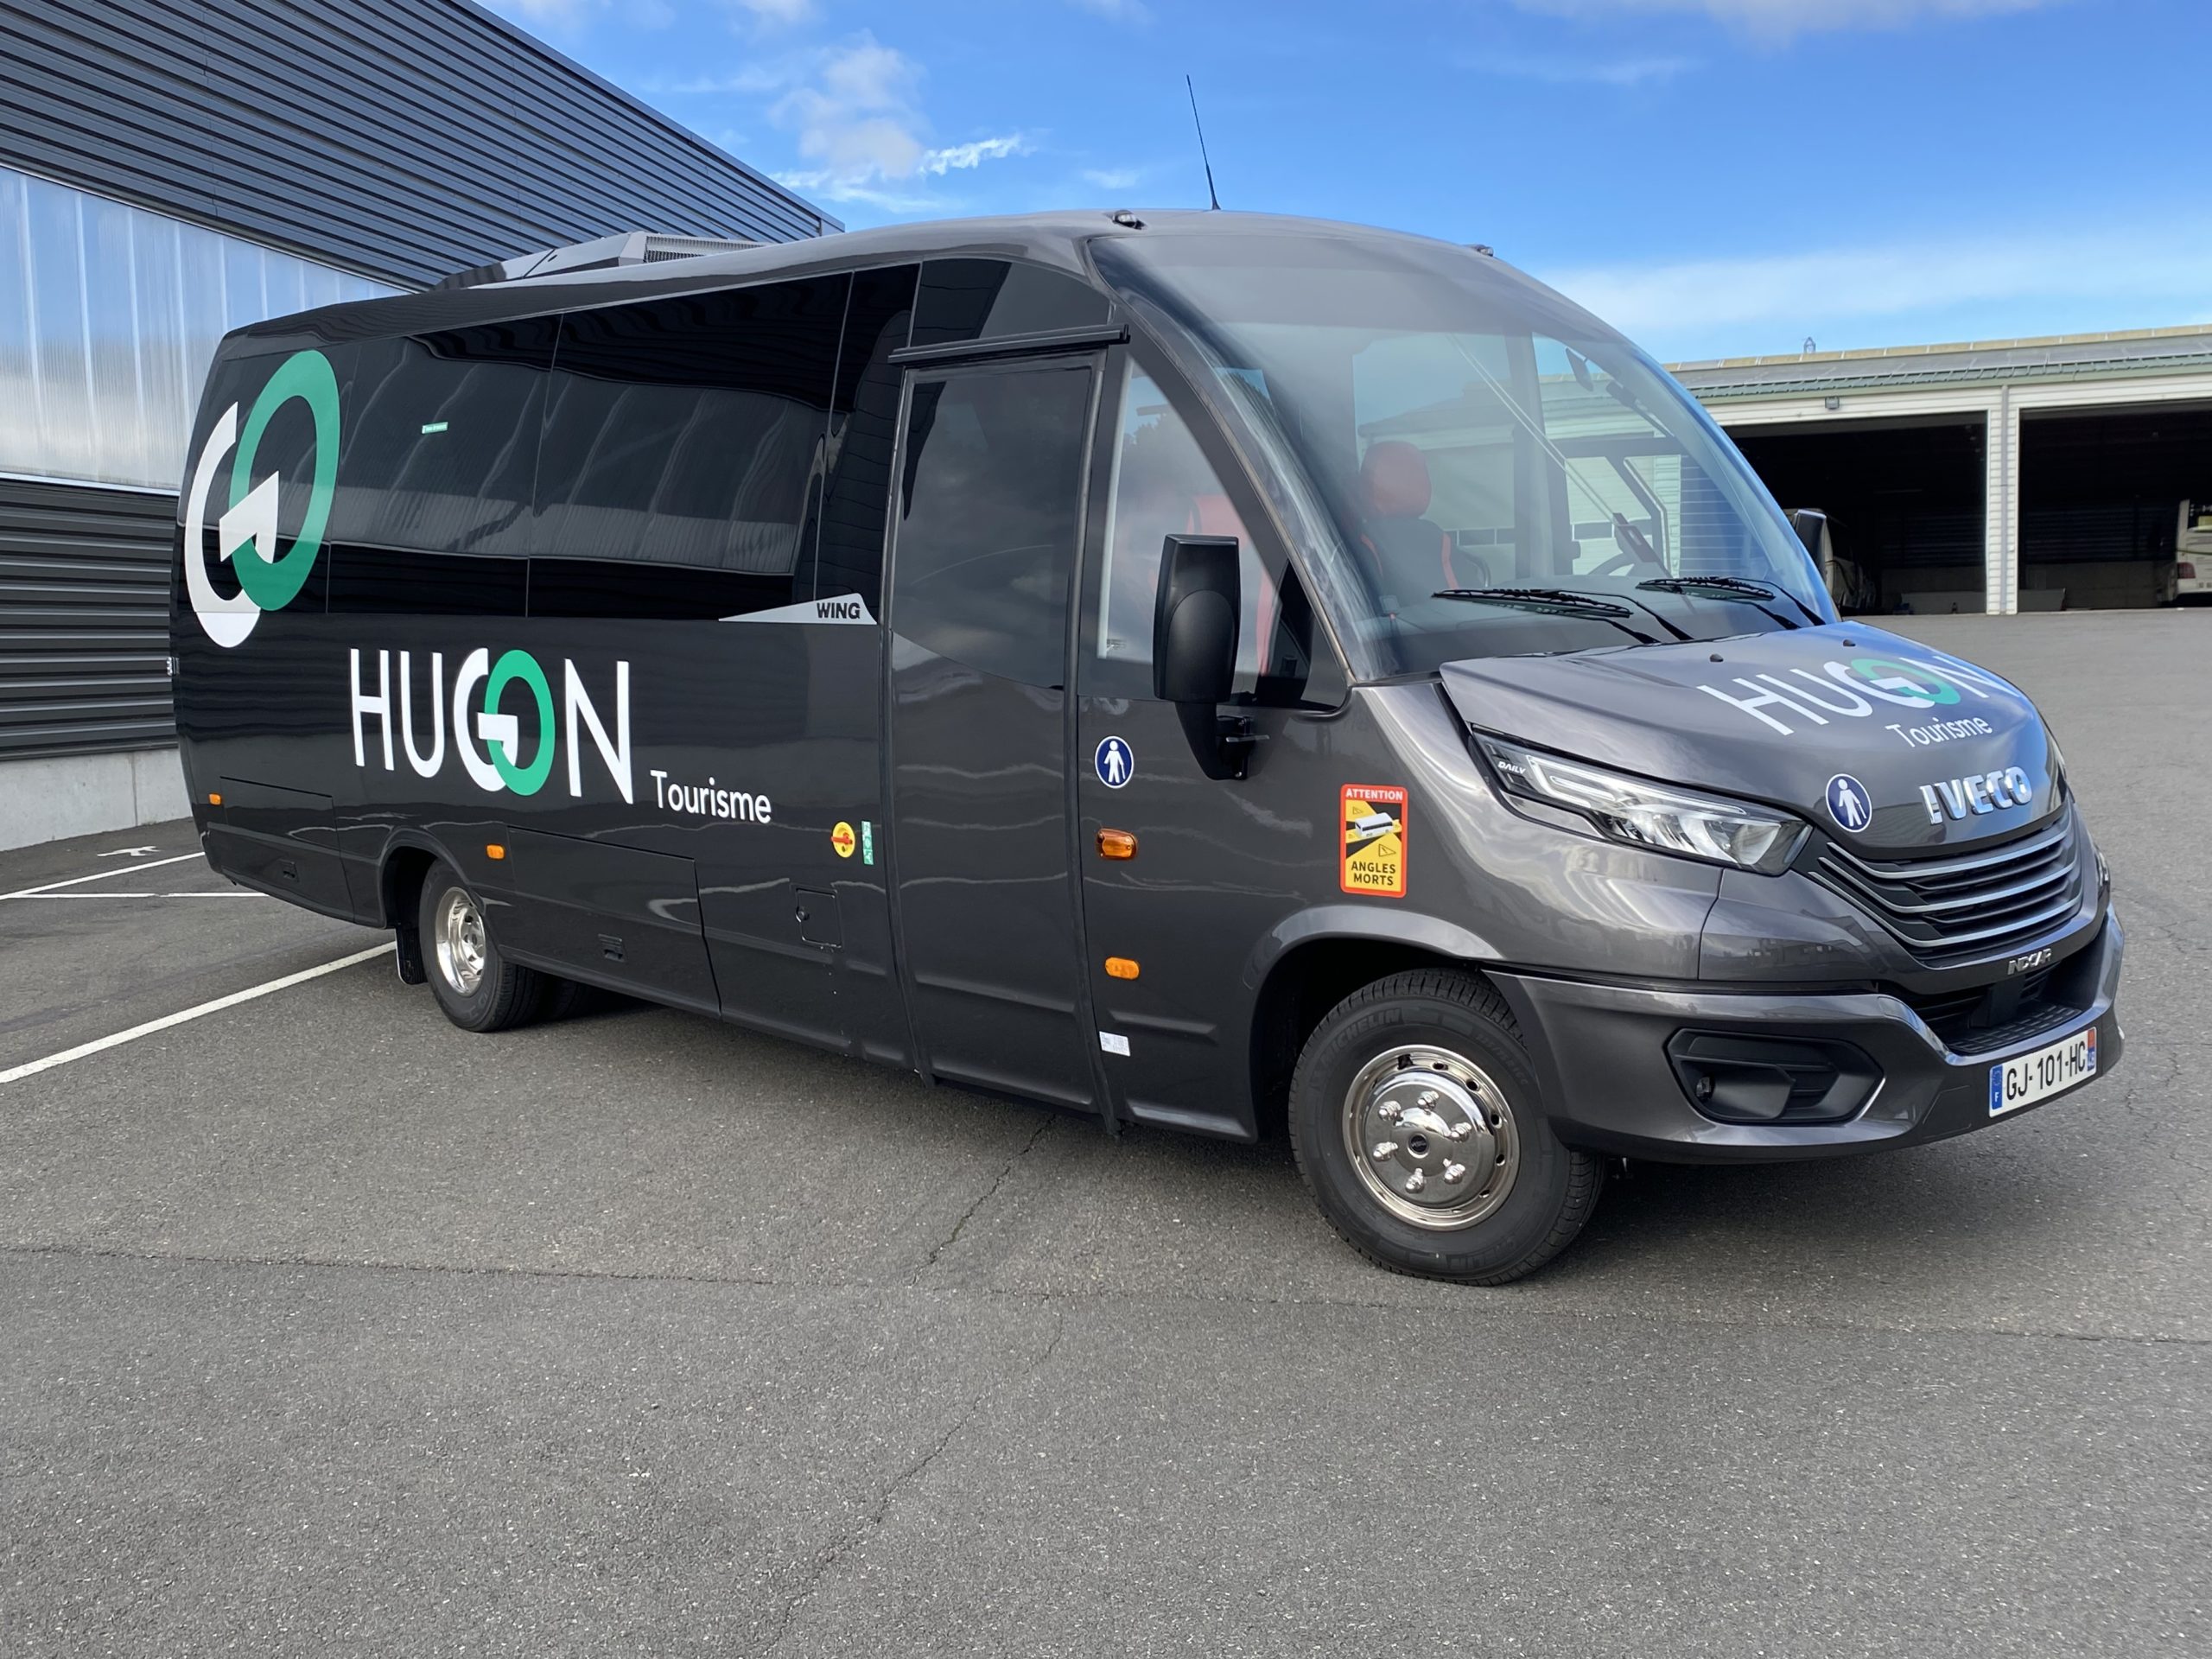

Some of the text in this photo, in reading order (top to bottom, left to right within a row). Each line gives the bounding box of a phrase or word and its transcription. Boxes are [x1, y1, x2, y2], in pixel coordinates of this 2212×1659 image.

[816, 602, 861, 620] WING
[1696, 655, 2021, 736] HUGON
[350, 647, 633, 804] HUGON
[1885, 715, 1993, 748] Tourisme
[1497, 760, 1527, 774] DAILY
[651, 769, 772, 823] Tourisme
[1345, 787, 1404, 801] ATTENTION
[1919, 766, 2033, 826] IVECO
[1351, 861, 1396, 874] ANGLES
[1353, 872, 1395, 887] MORTS
[2007, 948, 2052, 976] INDCAR
[1319, 1007, 1403, 1068] MICHELIN
[1994, 1092, 2000, 1103] F
